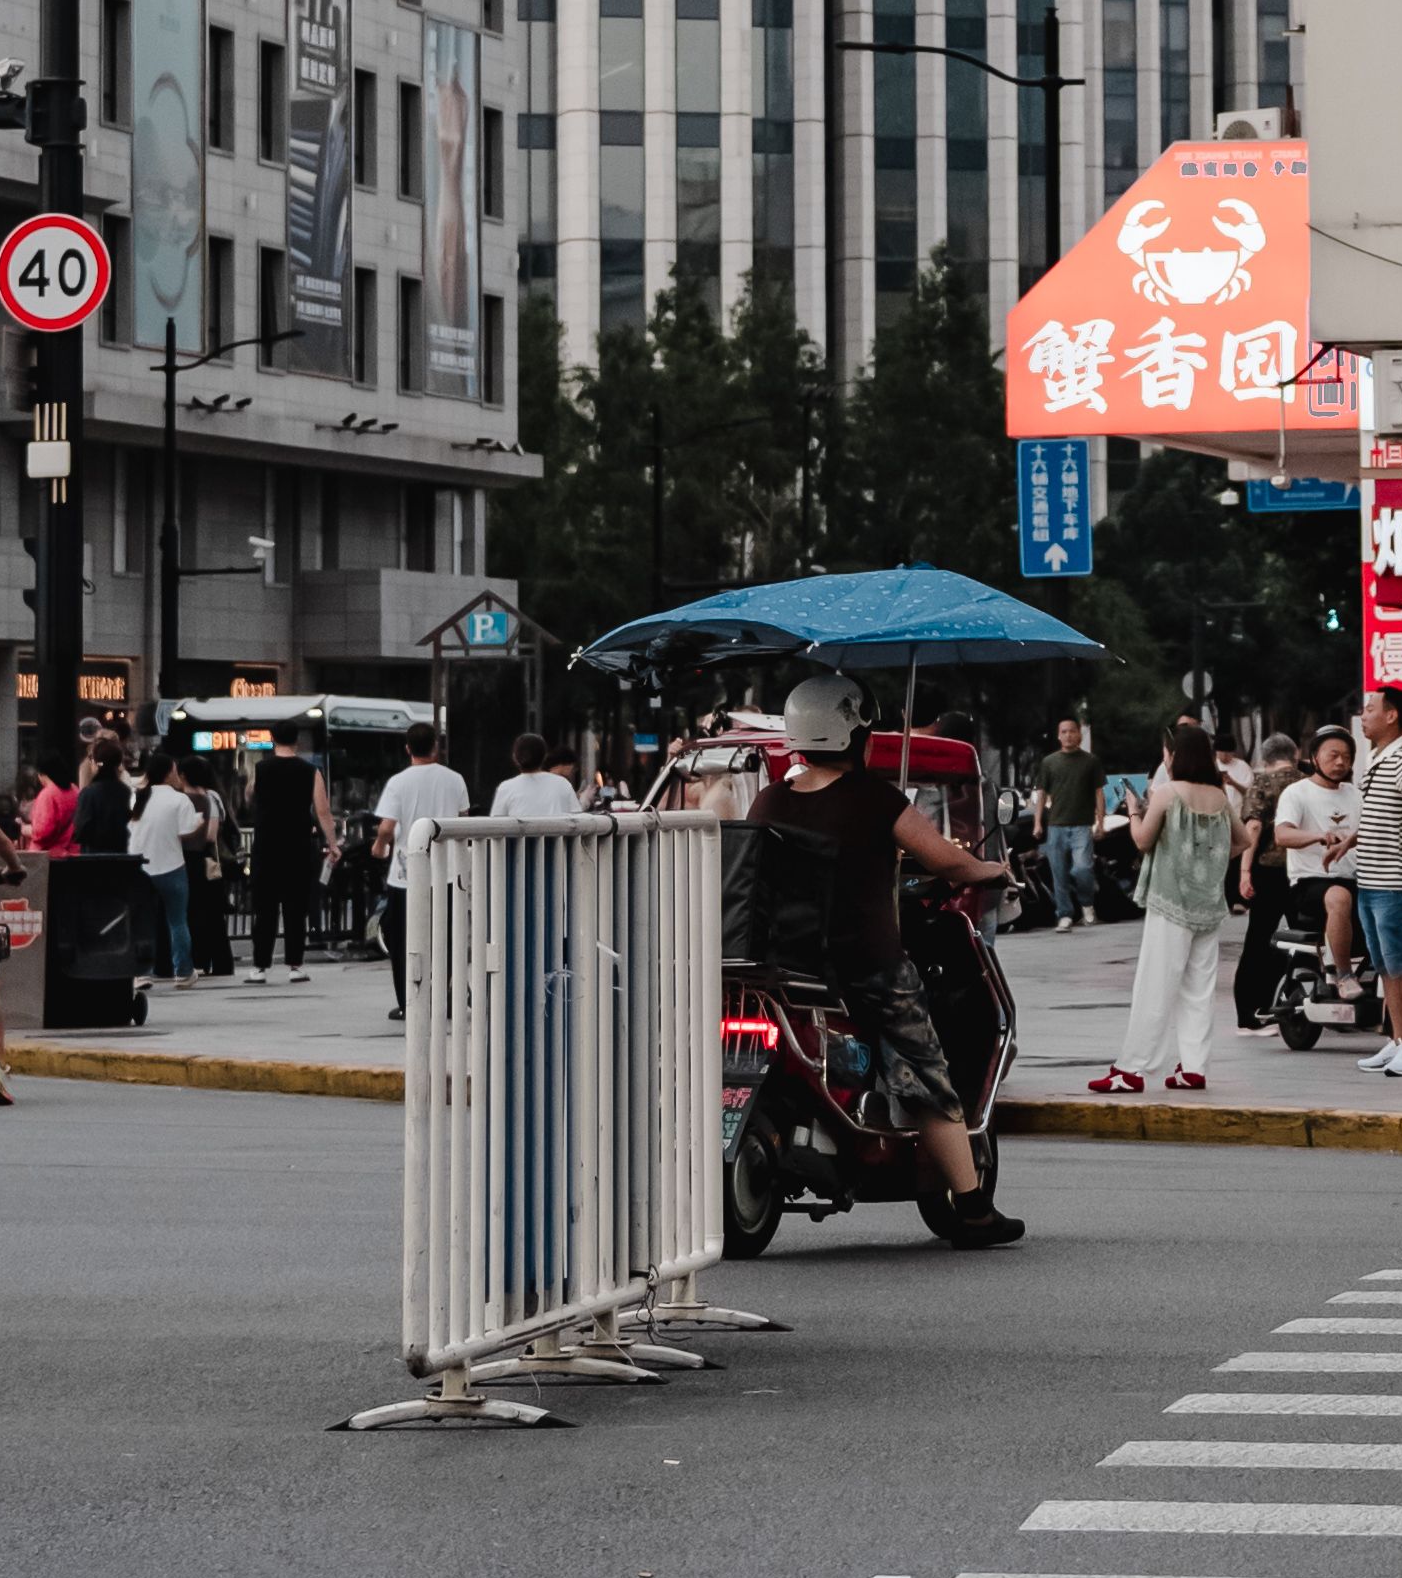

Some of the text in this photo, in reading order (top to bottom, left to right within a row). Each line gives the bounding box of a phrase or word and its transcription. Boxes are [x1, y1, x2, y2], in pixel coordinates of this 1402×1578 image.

[18, 248, 87, 298] 40
[1021, 316, 1298, 414] 蟹香园
[474, 614, 494, 642] P
[213, 731, 236, 750] 911
